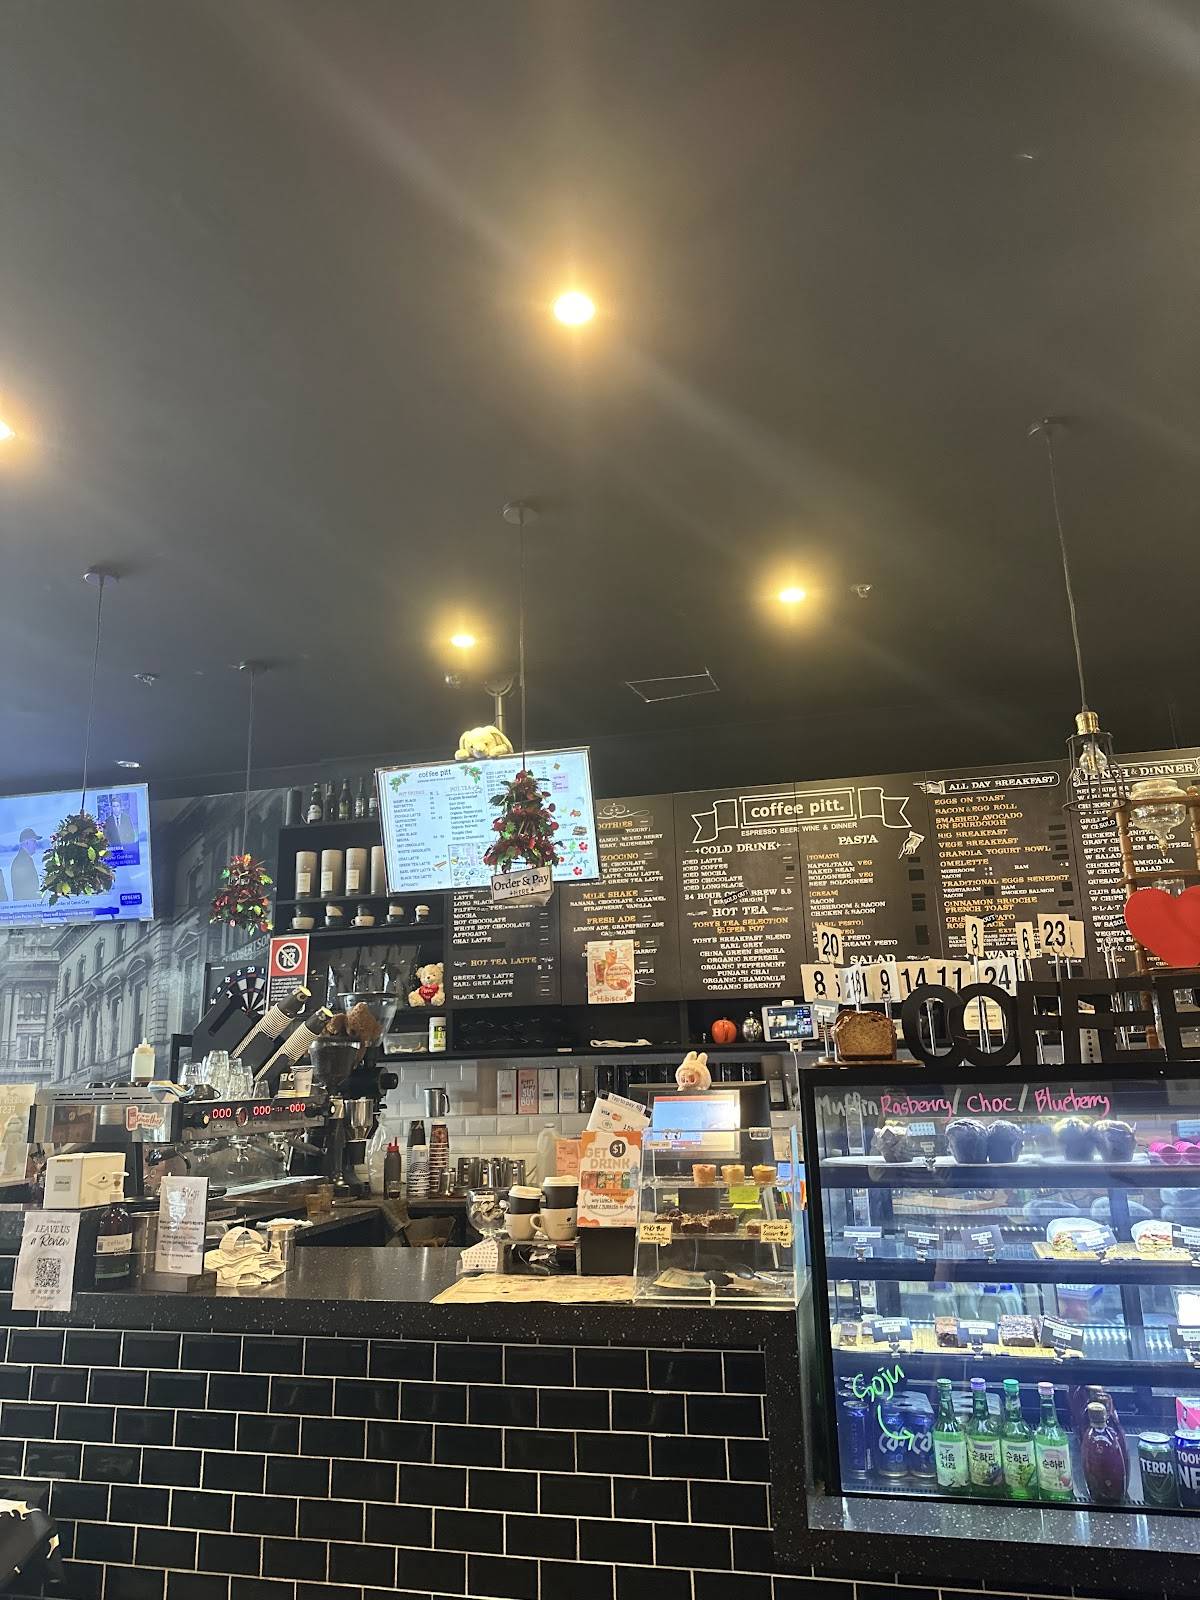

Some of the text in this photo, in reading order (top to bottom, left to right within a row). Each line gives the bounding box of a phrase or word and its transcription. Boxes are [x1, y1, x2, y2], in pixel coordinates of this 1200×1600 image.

[1139, 764, 1194, 777] DINNER
[995, 776, 1054, 787] BREAKFAST
[934, 797, 957, 805] EGGS
[976, 794, 1006, 803] TOAST
[751, 799, 844, 818] coffee pitt.
[935, 812, 1023, 824] SMASHED AVOCADO
[952, 820, 1007, 828] SOURDOUGH
[741, 828, 777, 837] ESPRESSO
[955, 829, 1008, 838] BREAKFAST
[838, 834, 878, 845] PASTA
[938, 838, 1018, 849] VEGE BREAKFAST
[700, 842, 776, 854] COLD DRINK
[939, 847, 1021, 858] GRANOLA YOGURT
[940, 858, 989, 868] OMELETTE
[1086, 861, 1120, 869] CHICKEN
[1135, 865, 1161, 873] SALAD
[494, 875, 549, 891] Order & Pay
[942, 879, 999, 888] TRADITIONAL
[608, 890, 638, 898] SHAKE
[698, 892, 721, 900] HOUR
[738, 890, 749, 899] OUT
[1100, 894, 1123, 902] CHIPS
[712, 906, 768, 918] HOT TEA
[586, 917, 615, 925] FRESH
[742, 917, 788, 925] SELECTION
[971, 923, 978, 949] 3
[1022, 928, 1030, 950] 6
[1044, 921, 1067, 946] 23
[822, 932, 839, 957] 20
[282, 953, 296, 967] 18
[707, 956, 741, 964] ORGANIC
[850, 954, 896, 964] SALAD
[814, 970, 826, 995] 8
[880, 969, 890, 994] 9
[901, 968, 928, 993] 14
[937, 967, 963, 993] 11
[985, 964, 1012, 990] 24
[901, 982, 1200, 1070] COFFEE
[816, 1092, 879, 1116] Muffin
[966, 1093, 1017, 1113] Choc
[1034, 1087, 1110, 1116] Blueberry
[586, 1148, 607, 1158] GET
[612, 1144, 623, 1154] $1
[590, 1158, 630, 1169] DRINK
[60, 1225, 70, 1233] US
[39, 1234, 70, 1248] Review
[972, 1452, 996, 1464] 순하리
[1006, 1451, 1030, 1463] 순하리
[1042, 1459, 1065, 1470] 순하리
[1140, 1458, 1173, 1474] TERRA
